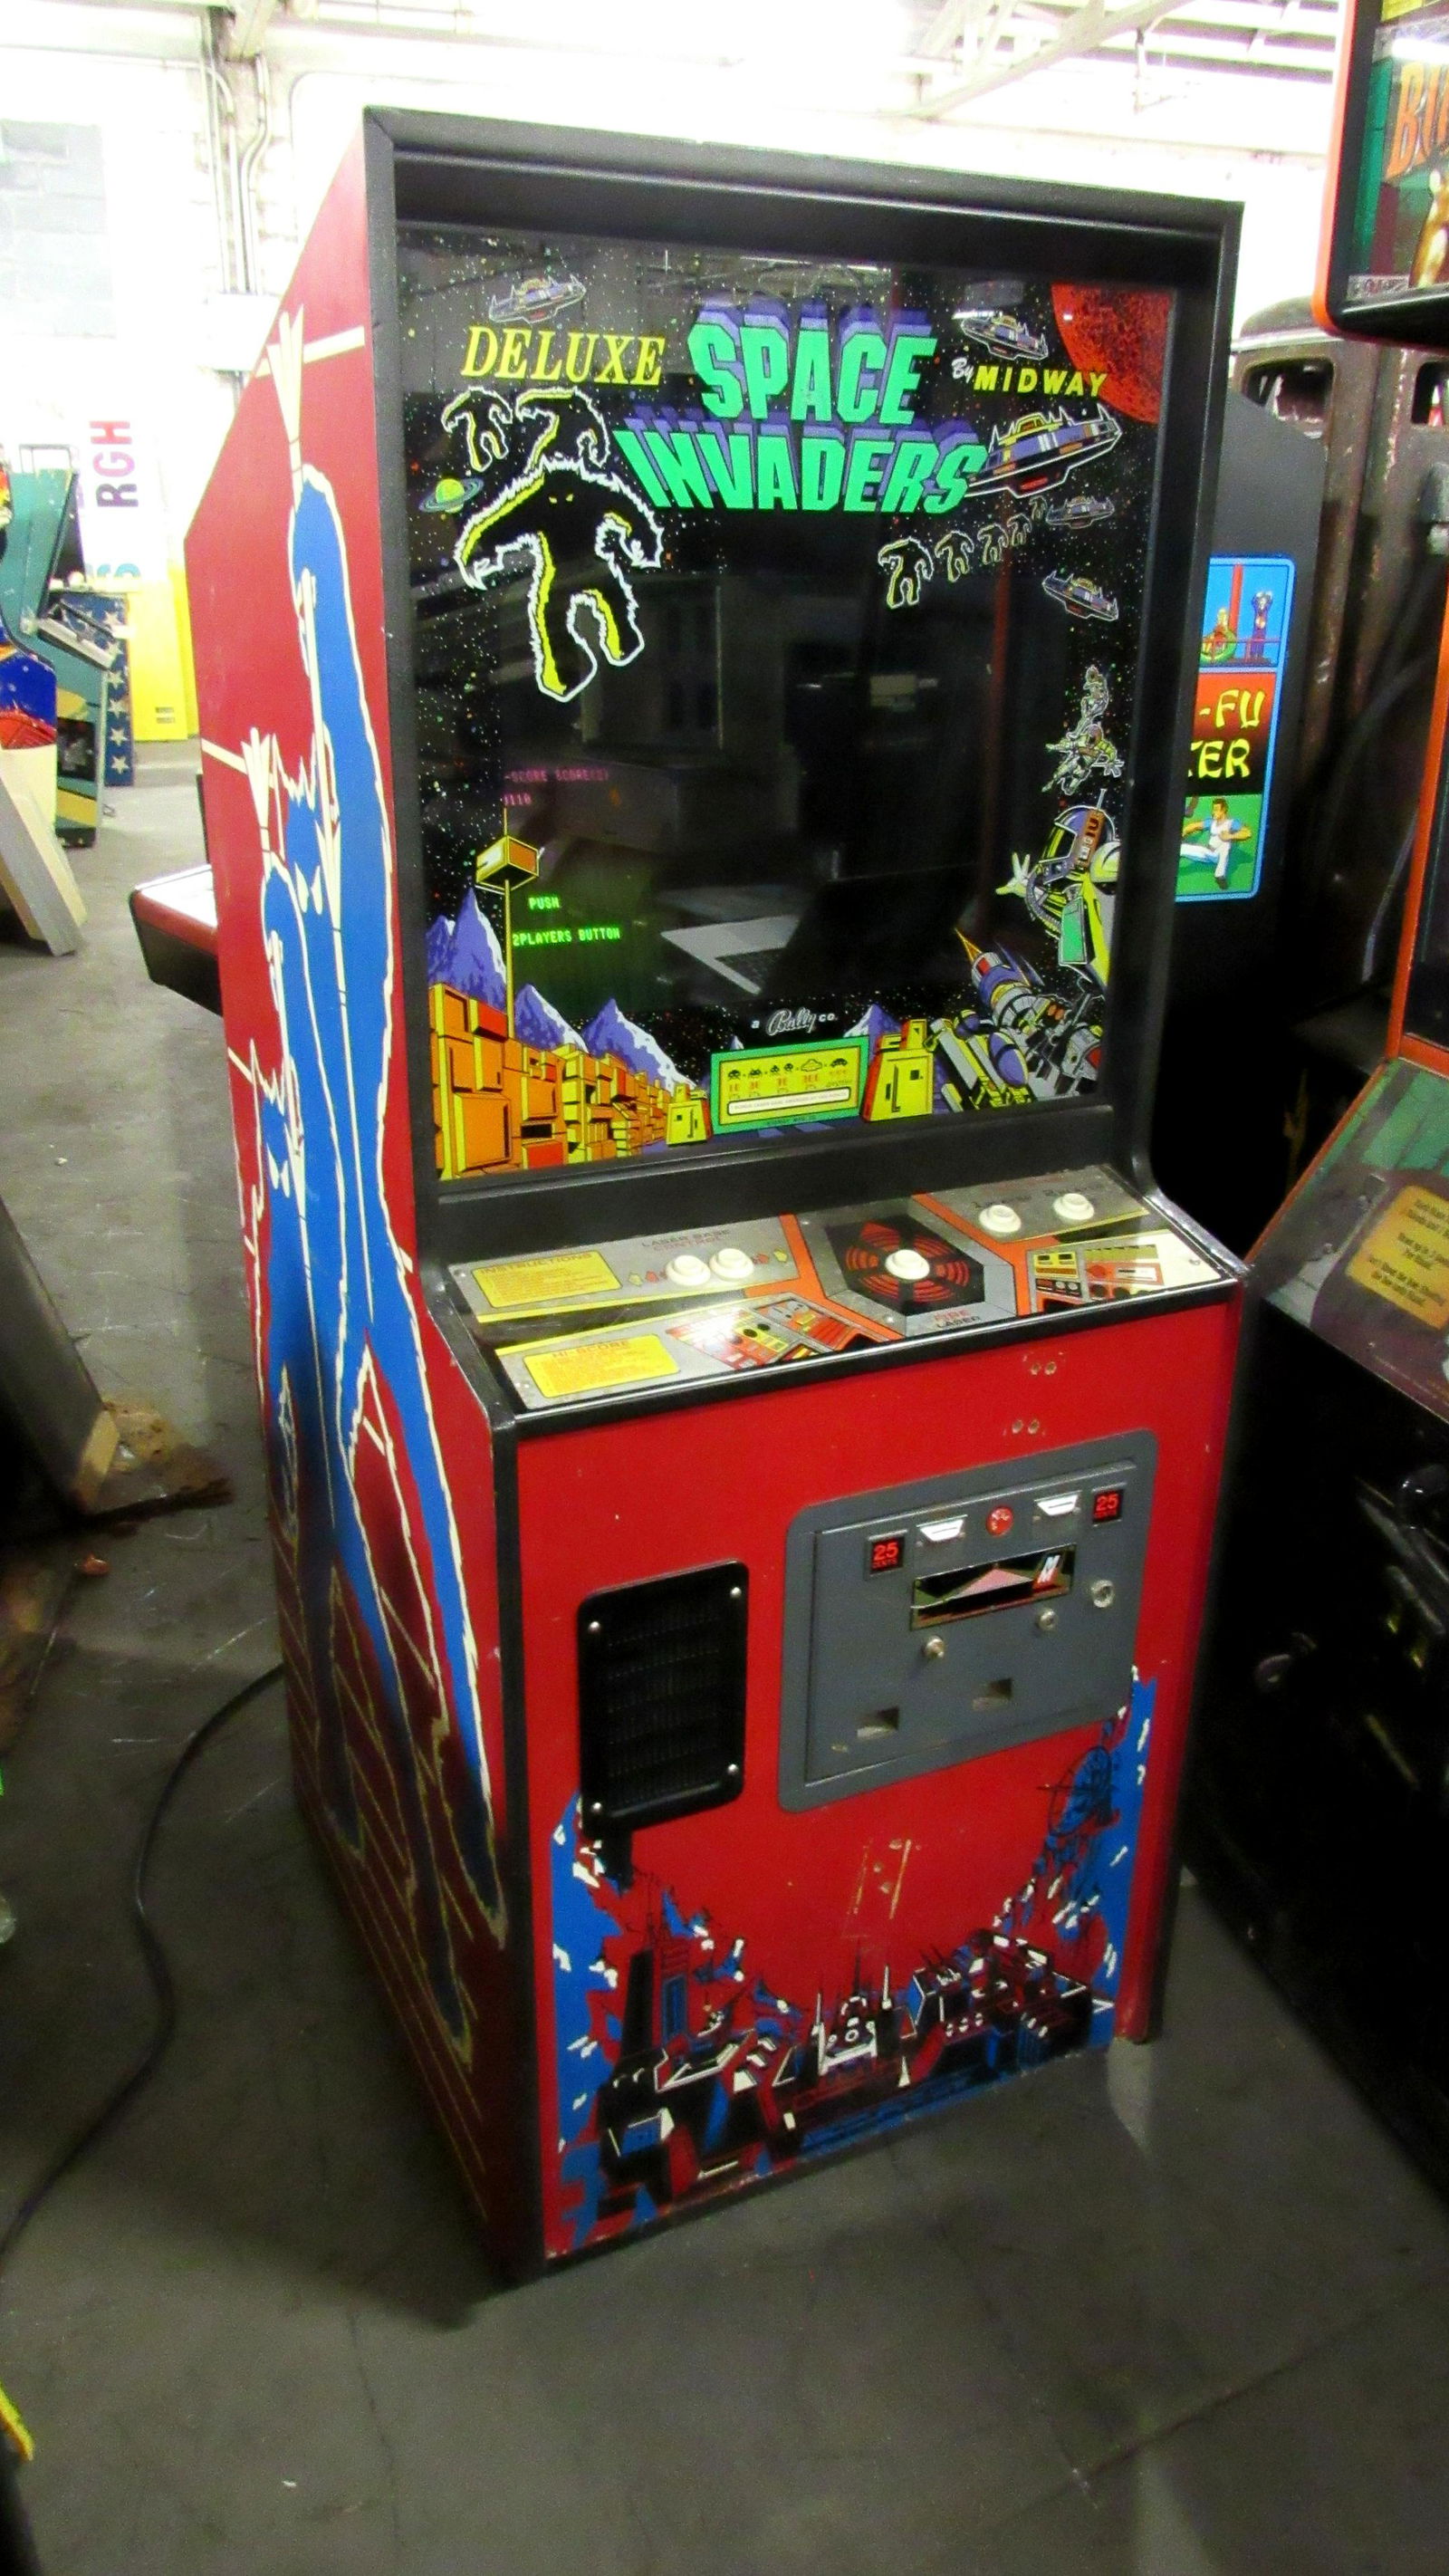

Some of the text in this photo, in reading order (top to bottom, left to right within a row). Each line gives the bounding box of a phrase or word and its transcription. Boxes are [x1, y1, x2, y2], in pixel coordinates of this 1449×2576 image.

[460, 325, 666, 387] DELUXE
[687, 317, 937, 425] SPACE
[951, 357, 1108, 398] By MIDWAY
[612, 429, 987, 514] INVADERS
[528, 896, 561, 910] PUSH
[513, 927, 621, 947] 2PLAYERS BUTTON
[766, 1007, 816, 1036] Bally
[1096, 1494, 1118, 1511] 25
[873, 1542, 899, 1561] 25
